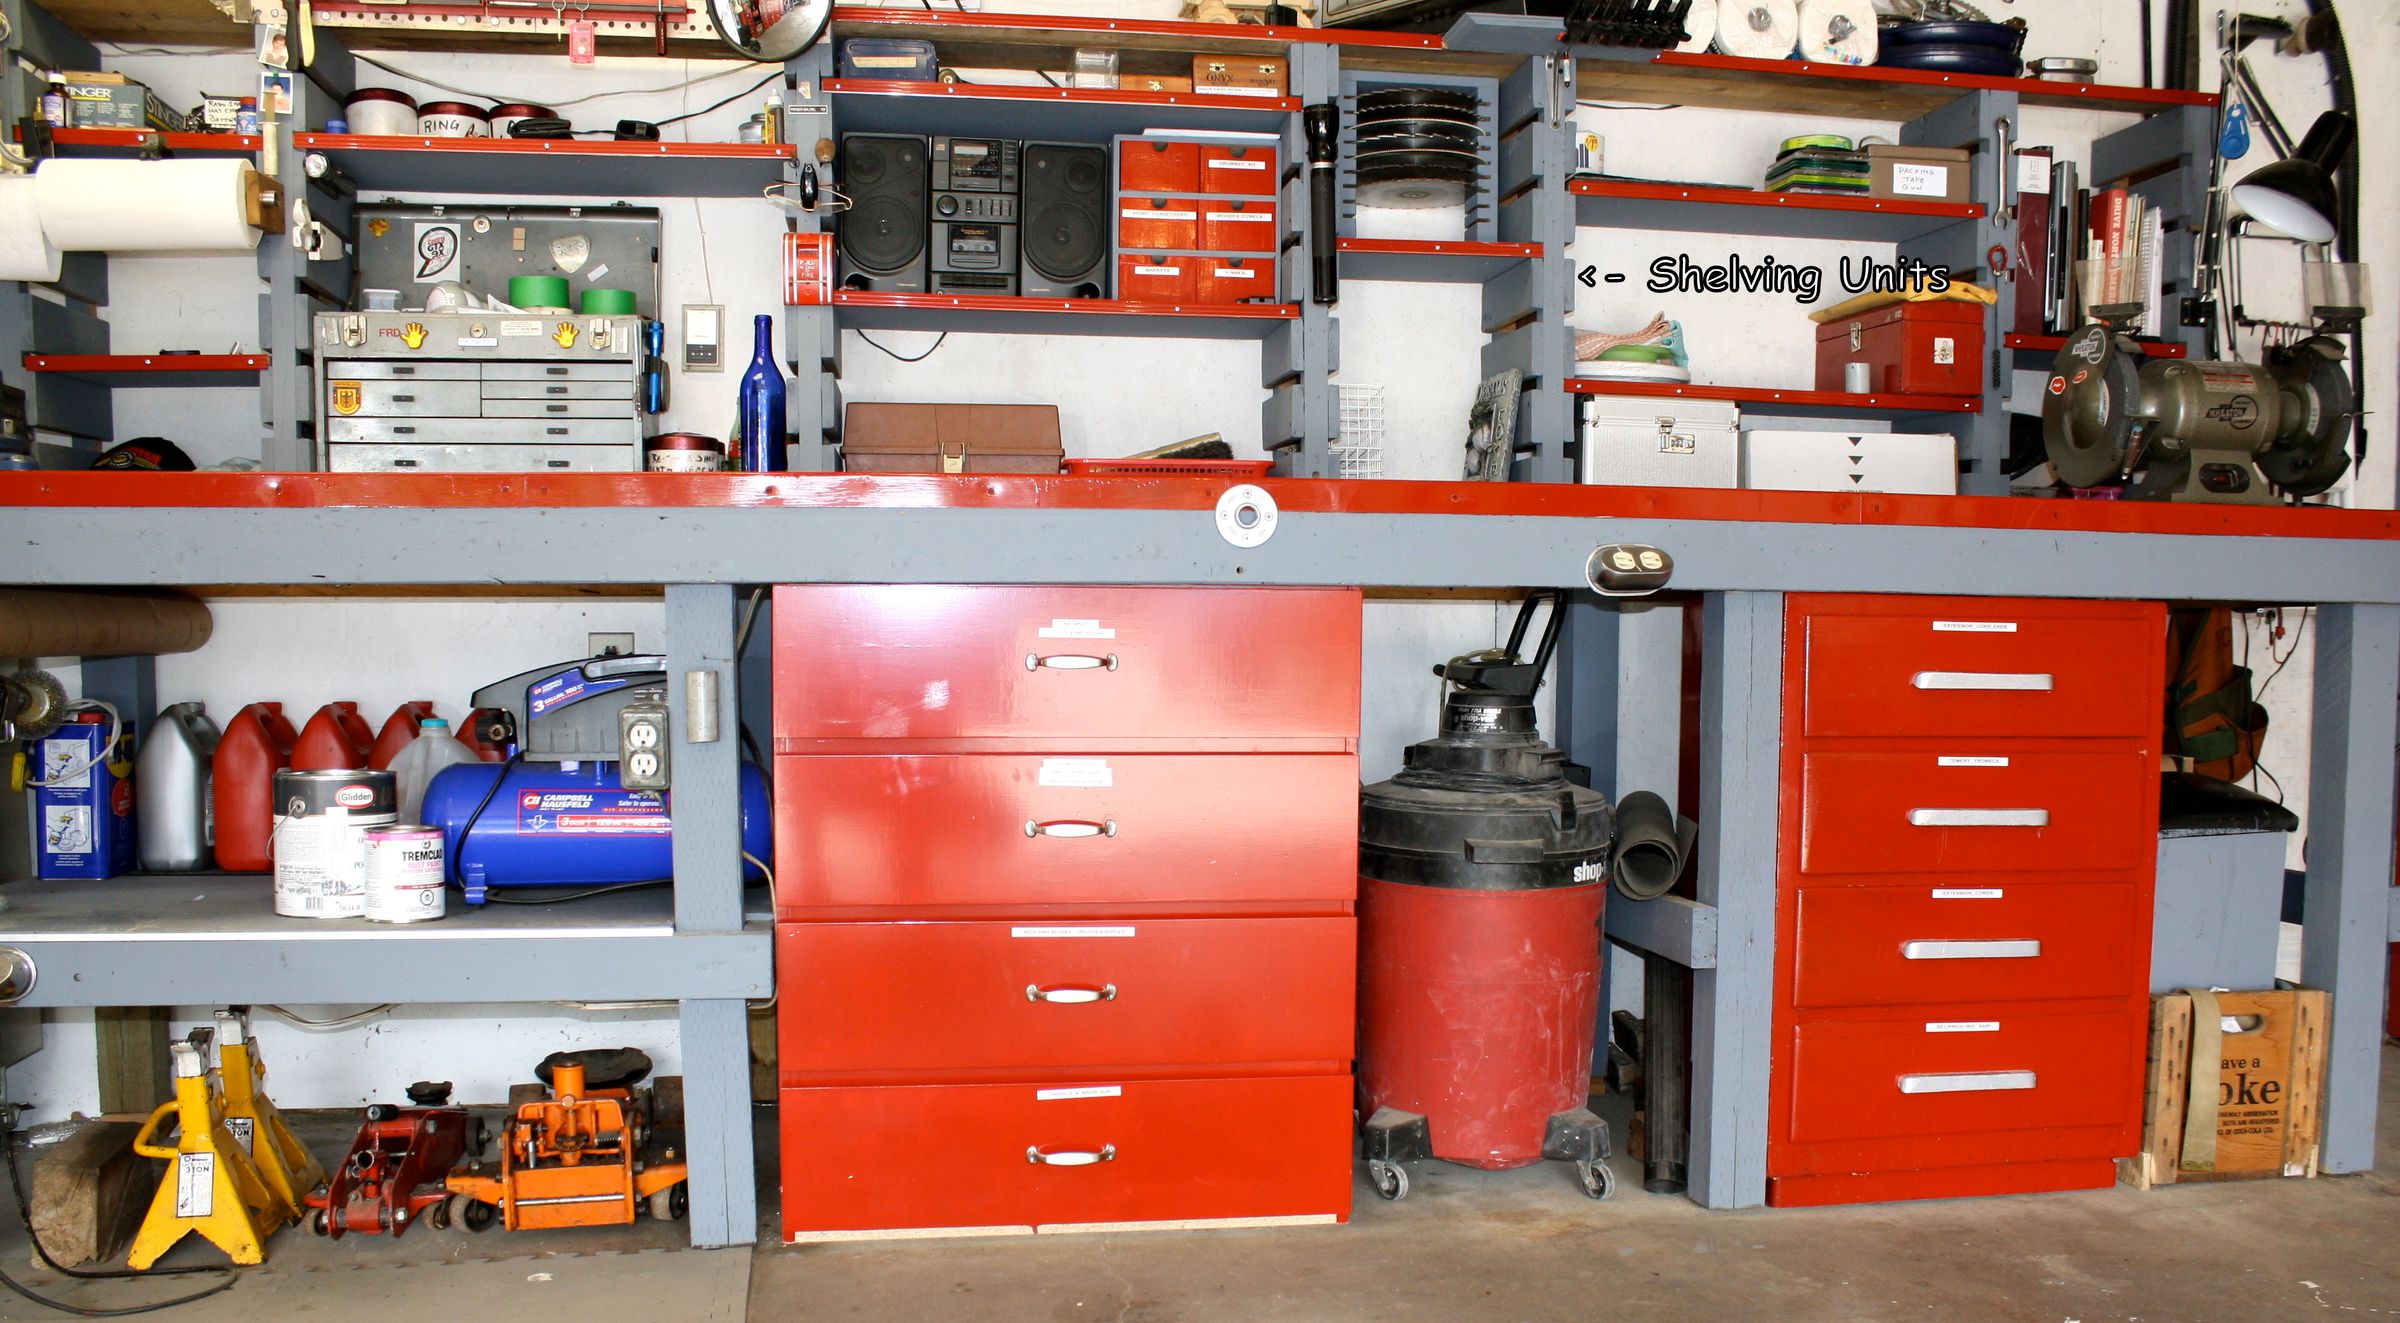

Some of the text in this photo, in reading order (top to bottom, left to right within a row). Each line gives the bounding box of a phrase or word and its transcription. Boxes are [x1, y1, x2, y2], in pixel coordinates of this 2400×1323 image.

[65, 87, 111, 98] TINGER
[424, 120, 459, 132] RING
[1898, 167, 1934, 175] PACKING
[2113, 197, 2122, 230] DRIVE
[379, 328, 400, 337] FRD
[533, 700, 545, 712] 3
[341, 793, 372, 801] Glidden
[540, 801, 591, 809] HAUSFELD
[402, 848, 443, 861] TREMCLAD
[1573, 861, 1606, 883] shop-
[2221, 1058, 2260, 1069] ave a
[2219, 1073, 2281, 1105] oke
[192, 1166, 210, 1174] TON
